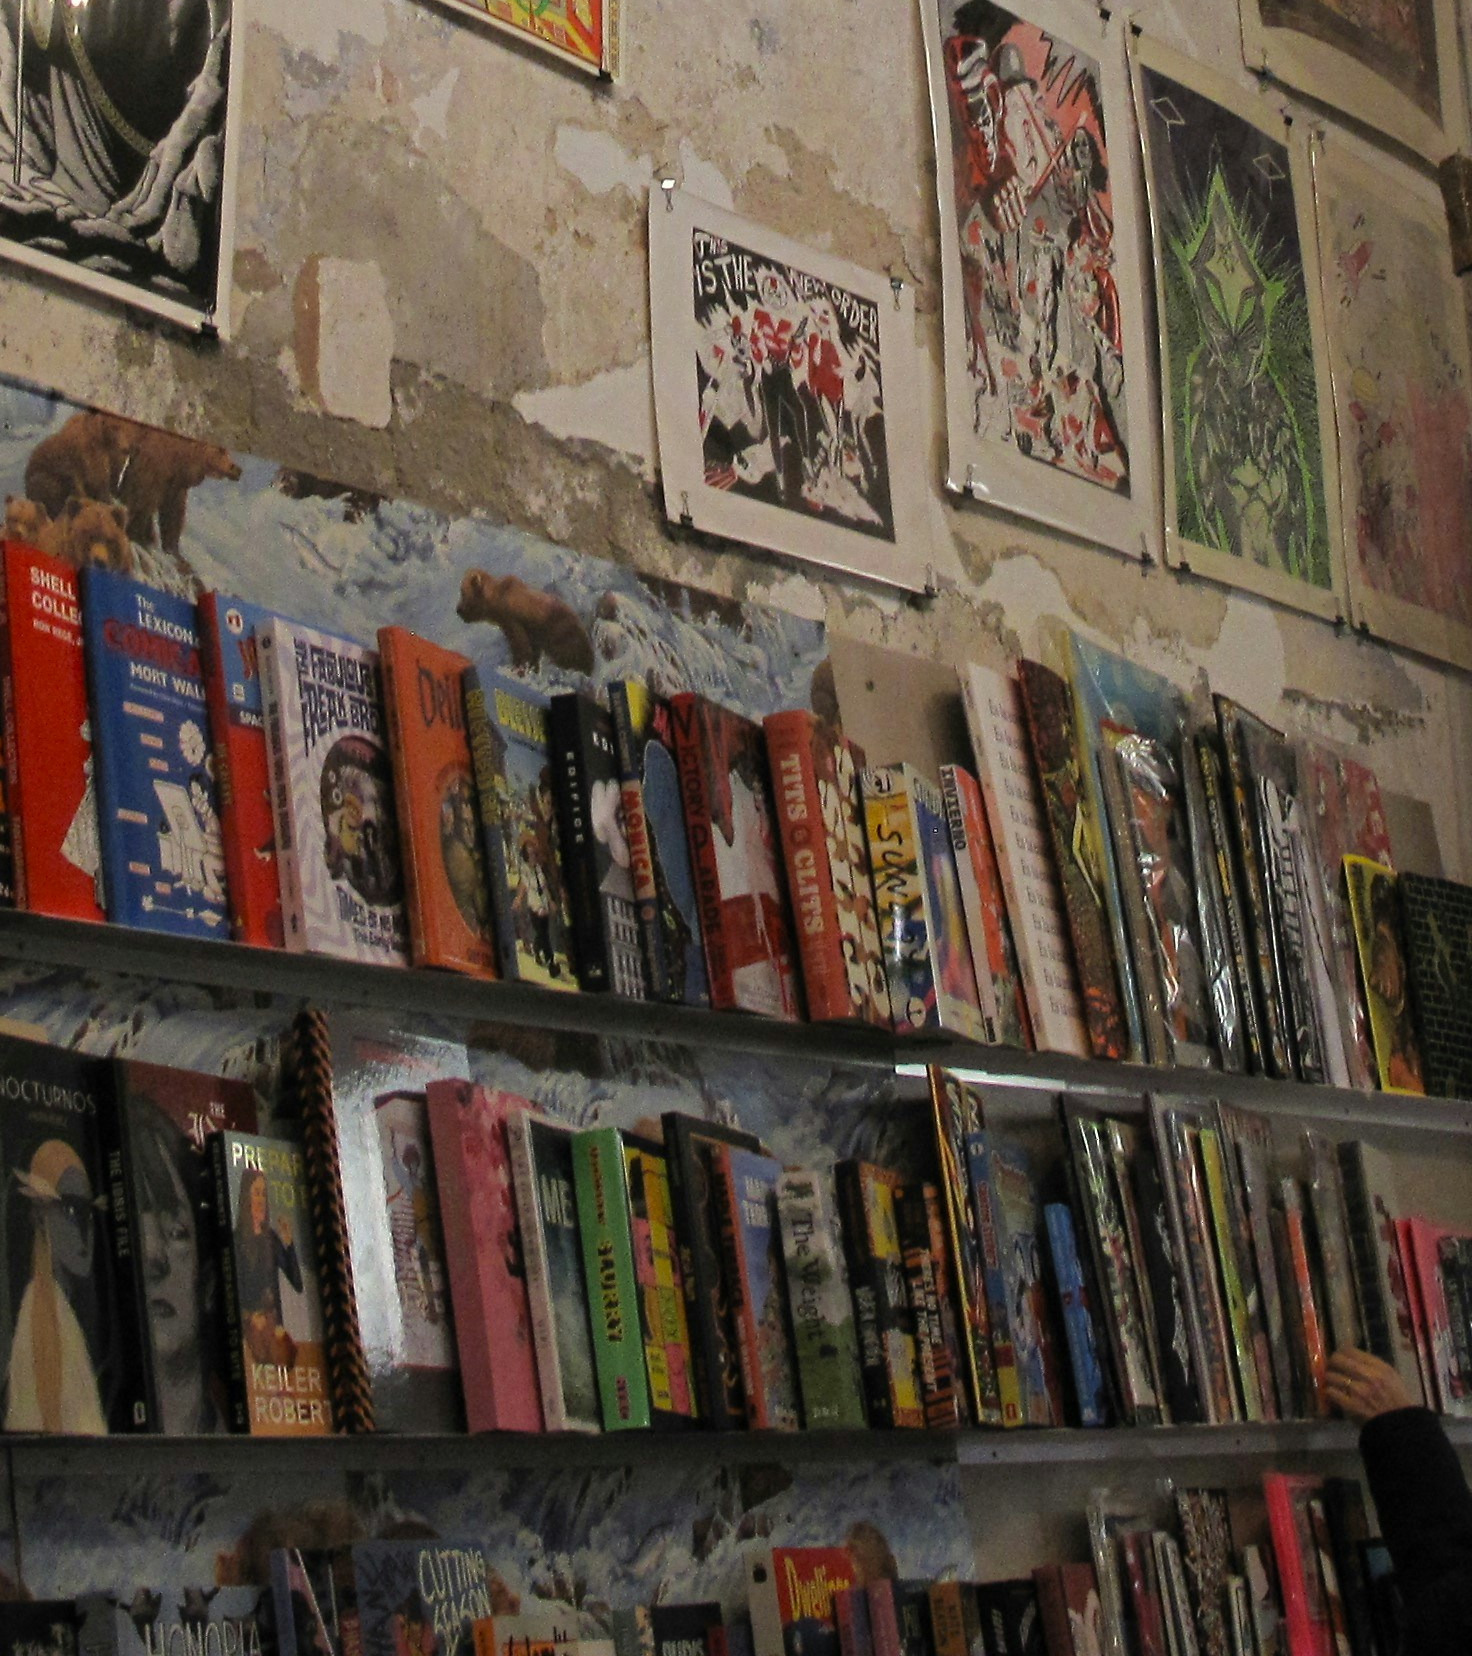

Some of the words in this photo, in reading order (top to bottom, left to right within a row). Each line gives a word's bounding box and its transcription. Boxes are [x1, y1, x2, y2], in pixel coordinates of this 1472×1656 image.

[695, 258, 720, 297] IS
[718, 254, 756, 294] THE
[831, 287, 879, 340] ORDER
[30, 565, 77, 601] SHELL
[137, 611, 193, 644] LEXICON
[129, 661, 168, 687] MORT
[672, 702, 709, 820] VICTORY
[779, 752, 808, 823] TITS
[621, 791, 652, 892] MONICA
[938, 766, 967, 852] INVIERNO
[793, 846, 826, 936] CLITS
[790, 1211, 813, 1255] The
[796, 1257, 826, 1341] Weight
[251, 1361, 322, 1393] KEILER
[418, 1547, 487, 1605] CUTTING
